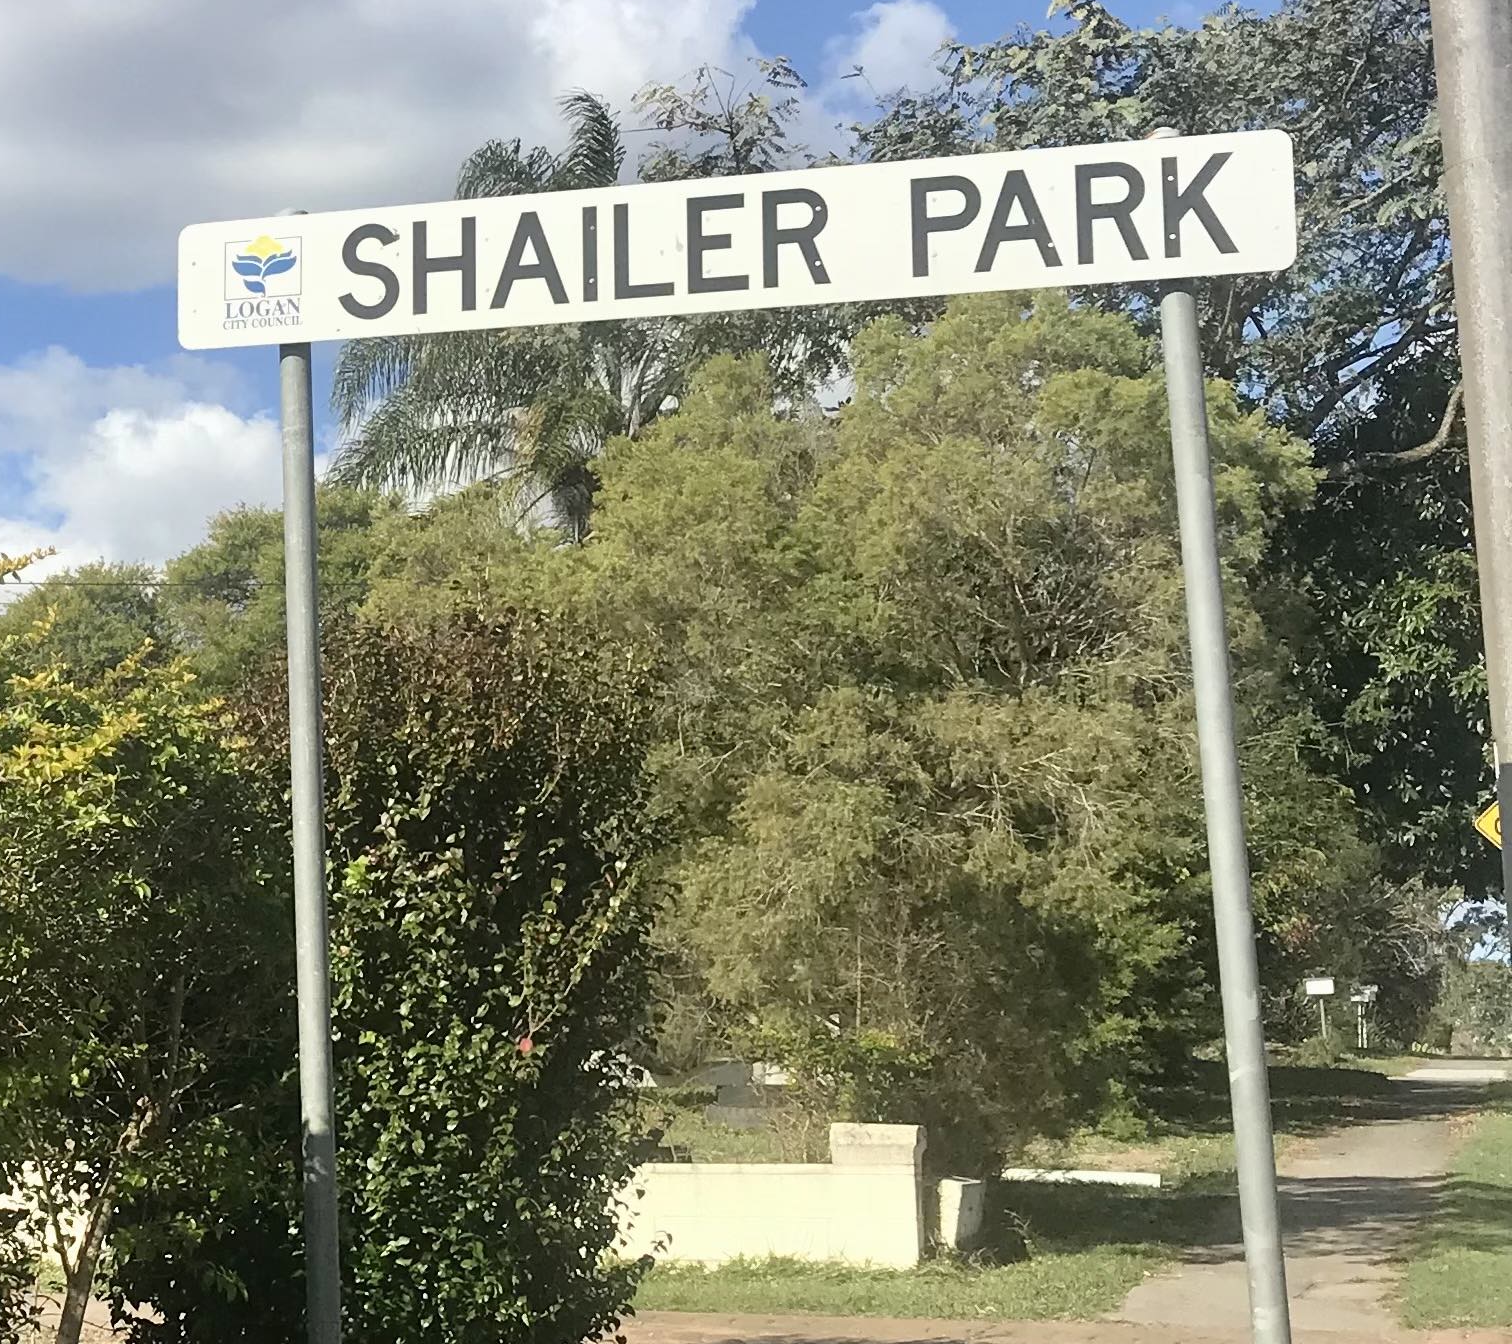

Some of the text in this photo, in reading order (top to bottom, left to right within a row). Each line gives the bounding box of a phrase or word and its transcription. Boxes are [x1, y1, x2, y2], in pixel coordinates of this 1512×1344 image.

[337, 150, 1239, 321] SHAILER PARK
[225, 297, 301, 319] LOGAN
[222, 315, 303, 330] CITY COUNCIL
